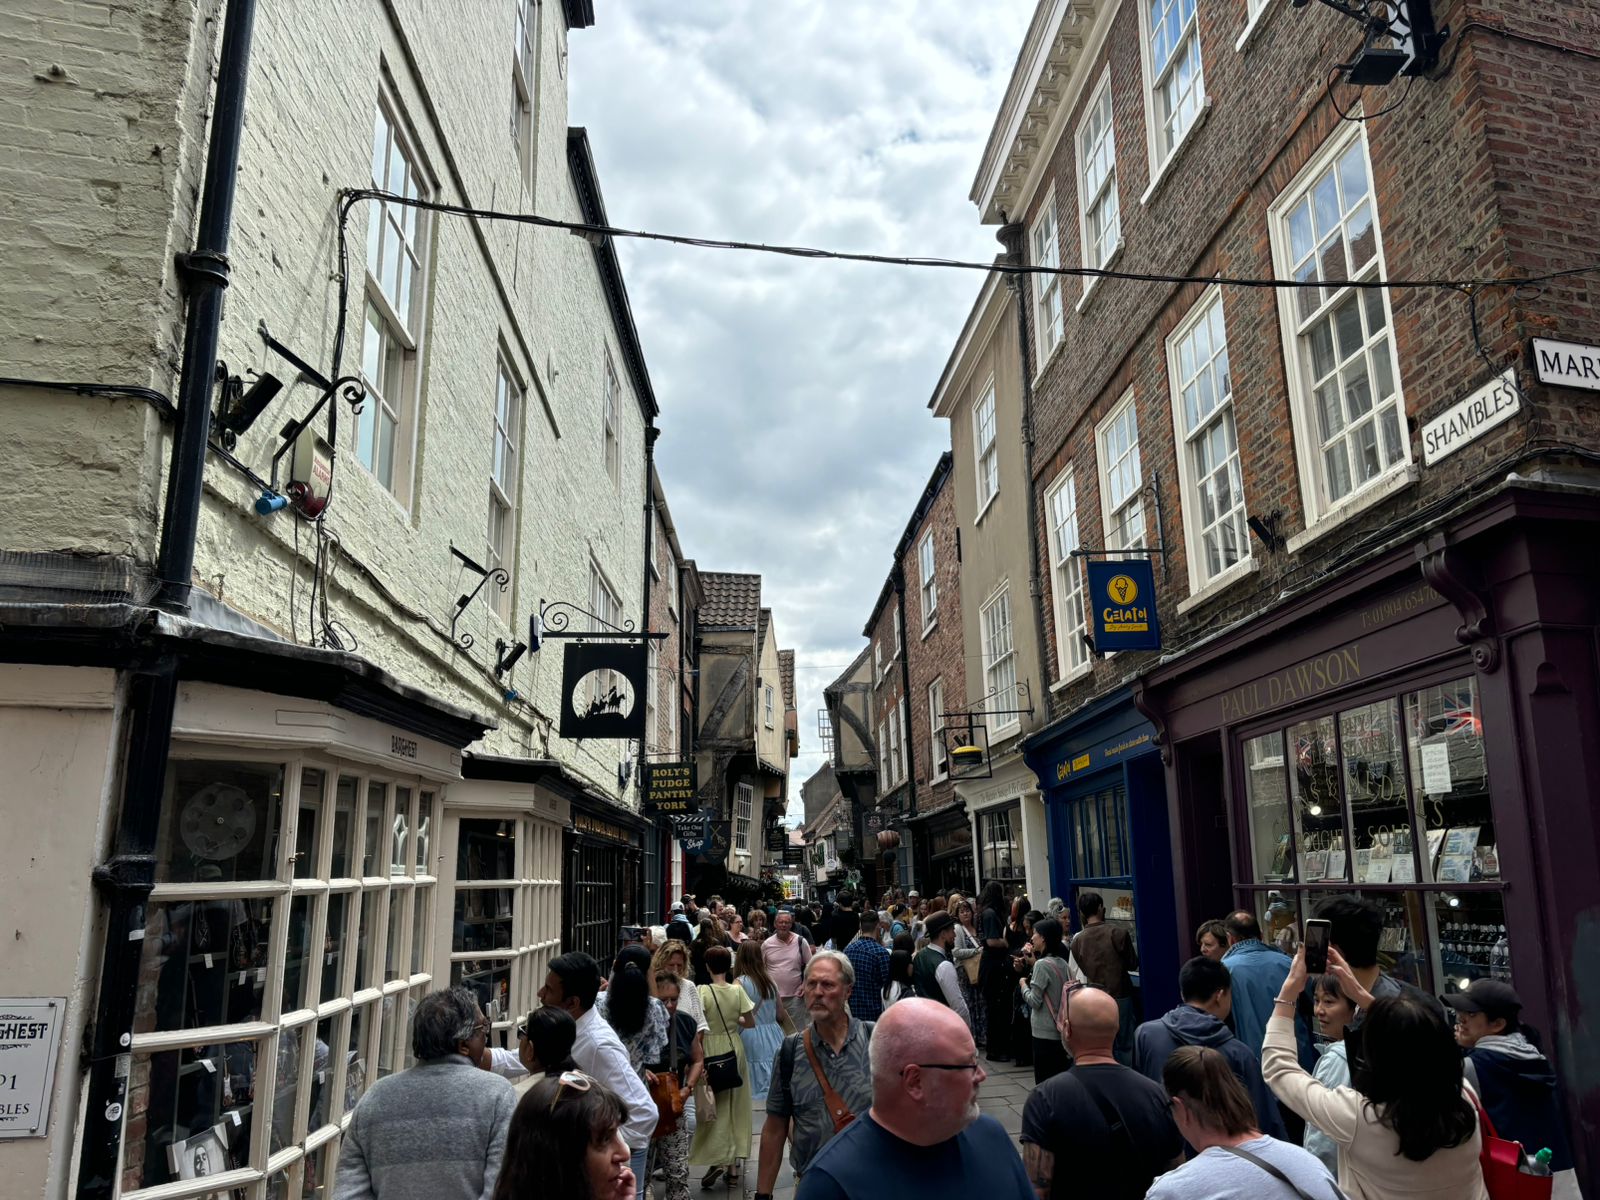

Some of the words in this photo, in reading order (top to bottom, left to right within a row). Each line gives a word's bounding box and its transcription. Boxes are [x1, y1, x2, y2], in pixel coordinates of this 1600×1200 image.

[1540, 349, 1600, 380] MAR
[1425, 380, 1515, 456] SHAMBLES
[1221, 684, 1264, 721] PAUL
[1268, 644, 1361, 707] DAWSON
[652, 767, 690, 778] ROLY'S
[652, 779, 691, 788] FUDGE
[649, 789, 694, 799] PANTRY
[656, 800, 688, 810] YORK
[686, 839, 704, 850] Shop
